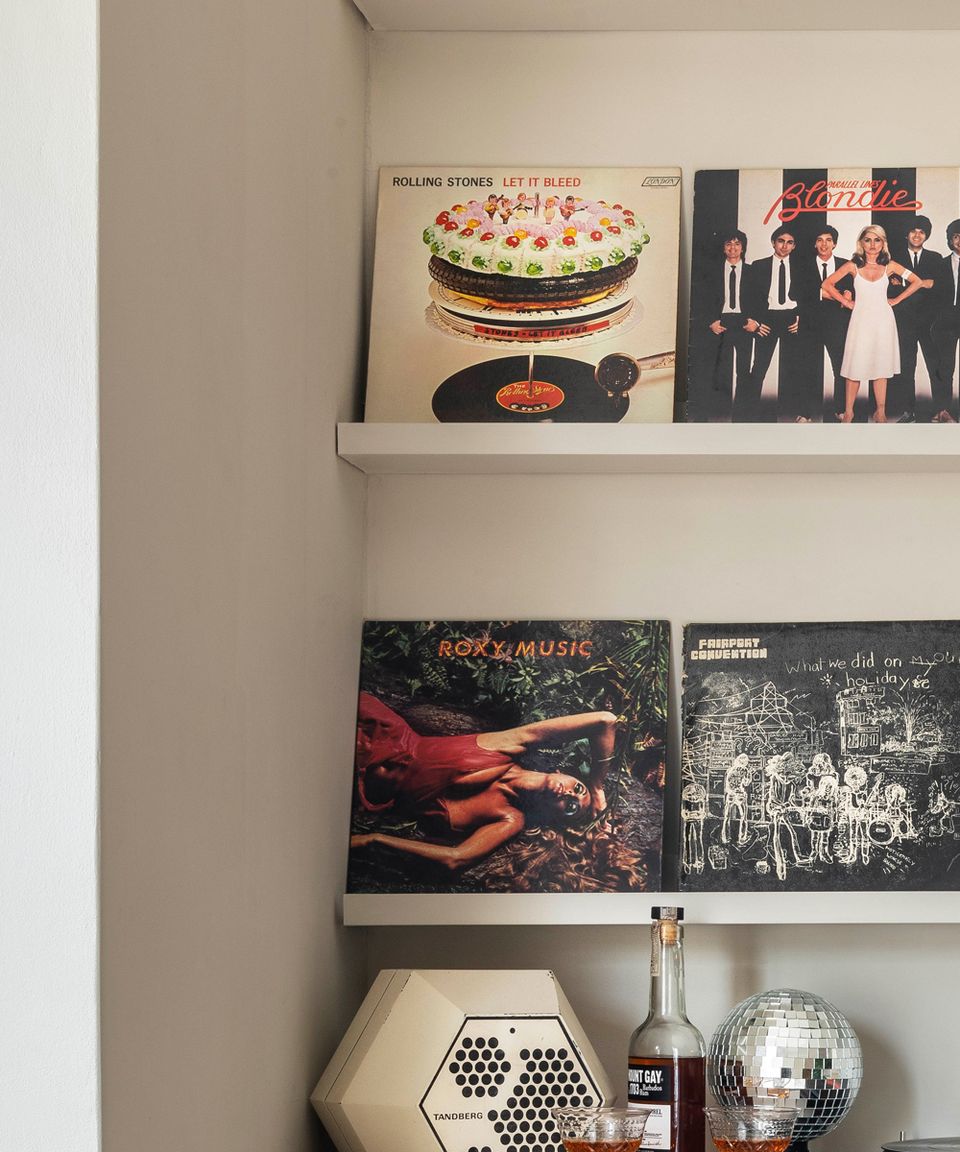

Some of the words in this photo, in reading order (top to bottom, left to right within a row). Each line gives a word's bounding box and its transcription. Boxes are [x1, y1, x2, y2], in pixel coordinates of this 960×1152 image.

[393, 177, 442, 187] ROLLING
[447, 177, 494, 187] STONES
[503, 177, 524, 187] LET
[529, 177, 539, 187] IT
[544, 177, 581, 187] BLEED
[763, 179, 923, 225] Blondie
[438, 640, 506, 657] ROXY
[514, 640, 593, 657] MUSIC
[699, 638, 760, 650] FAIRPORT
[690, 648, 768, 661] CONVENTION
[829, 659, 847, 669] we
[851, 651, 875, 669] did
[884, 657, 902, 668] on
[644, 1070, 662, 1084] GAY
[433, 1112, 483, 1121] TANDBERG
